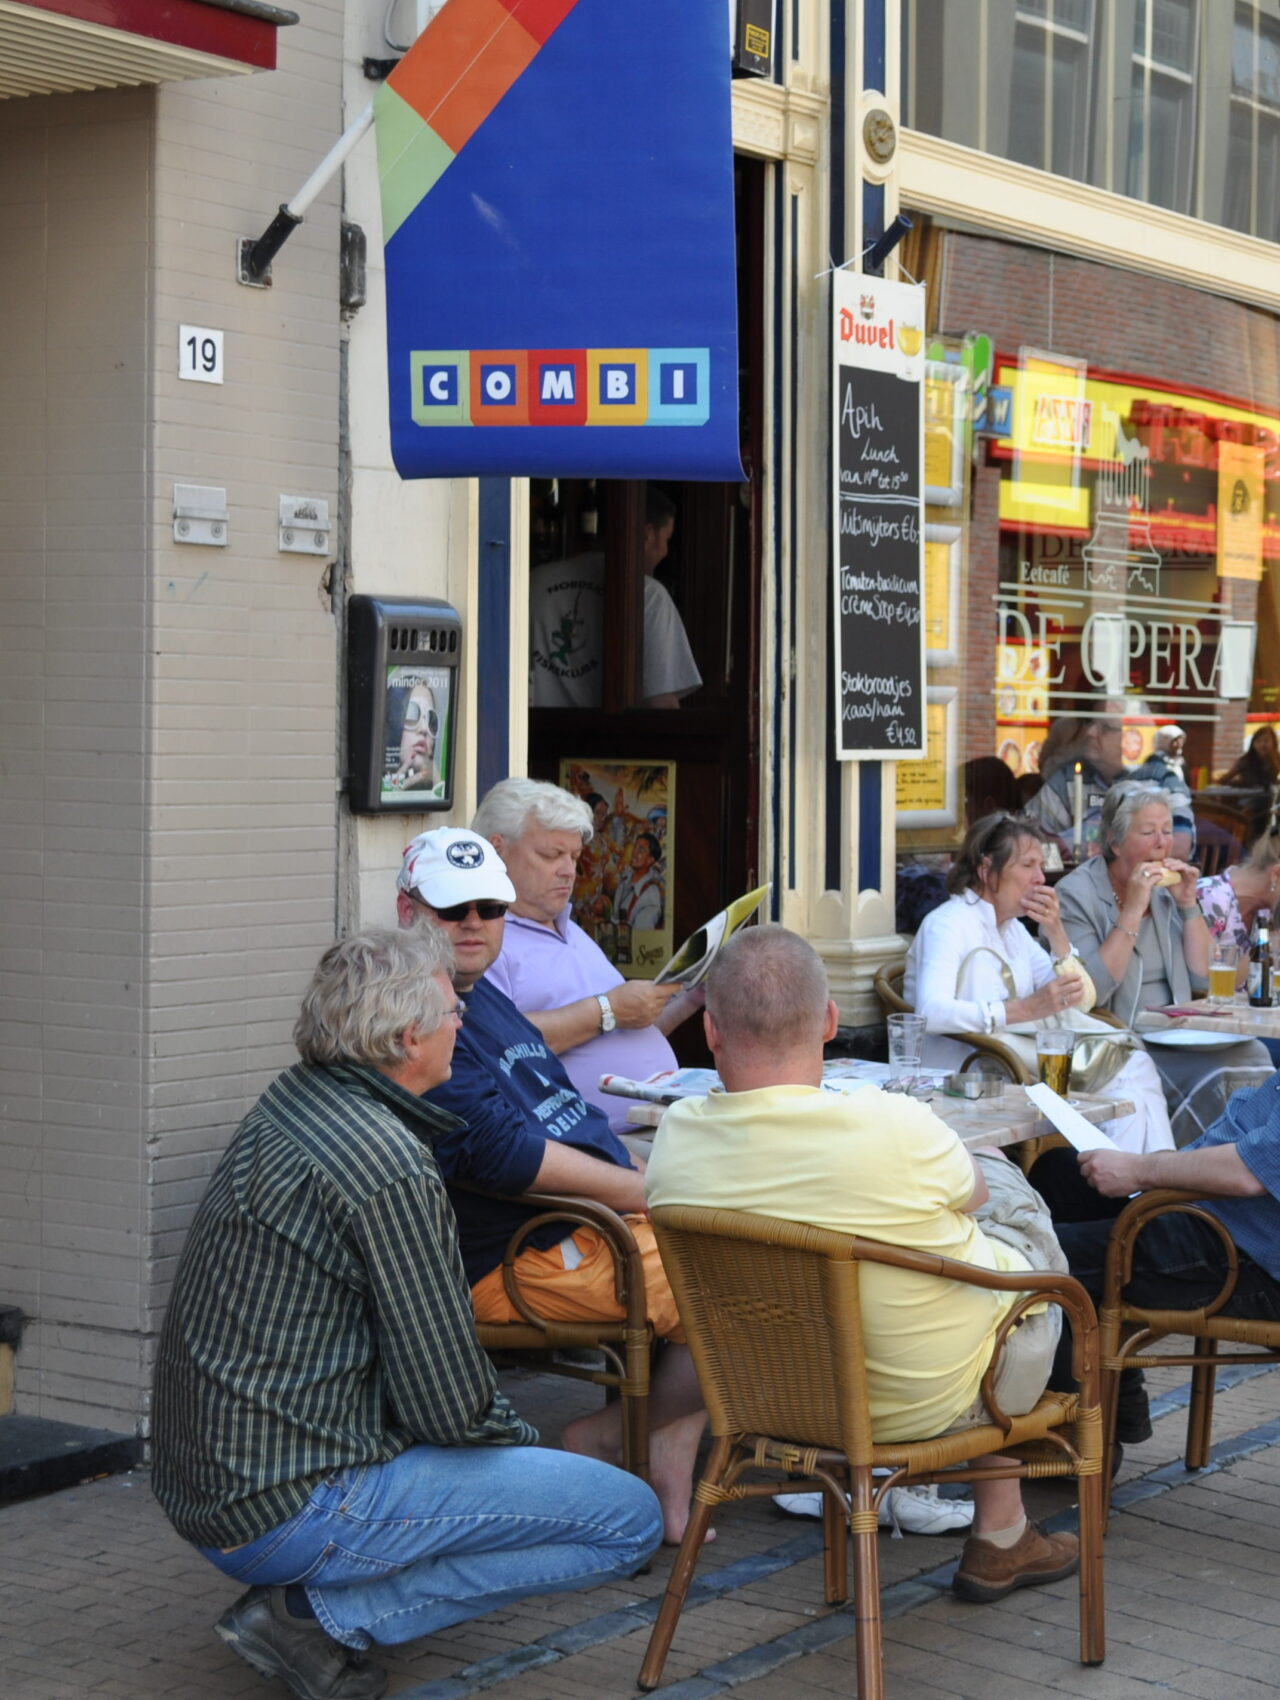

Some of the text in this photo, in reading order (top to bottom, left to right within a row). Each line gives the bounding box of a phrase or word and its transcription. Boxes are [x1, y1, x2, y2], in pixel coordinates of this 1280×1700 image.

[839, 307, 895, 350] Duvel
[186, 336, 217, 373] 19
[428, 369, 685, 401] COMBI
[860, 437, 900, 464] Lunch
[1019, 560, 1070, 585] Eetcafé
[996, 608, 1067, 684] DE
